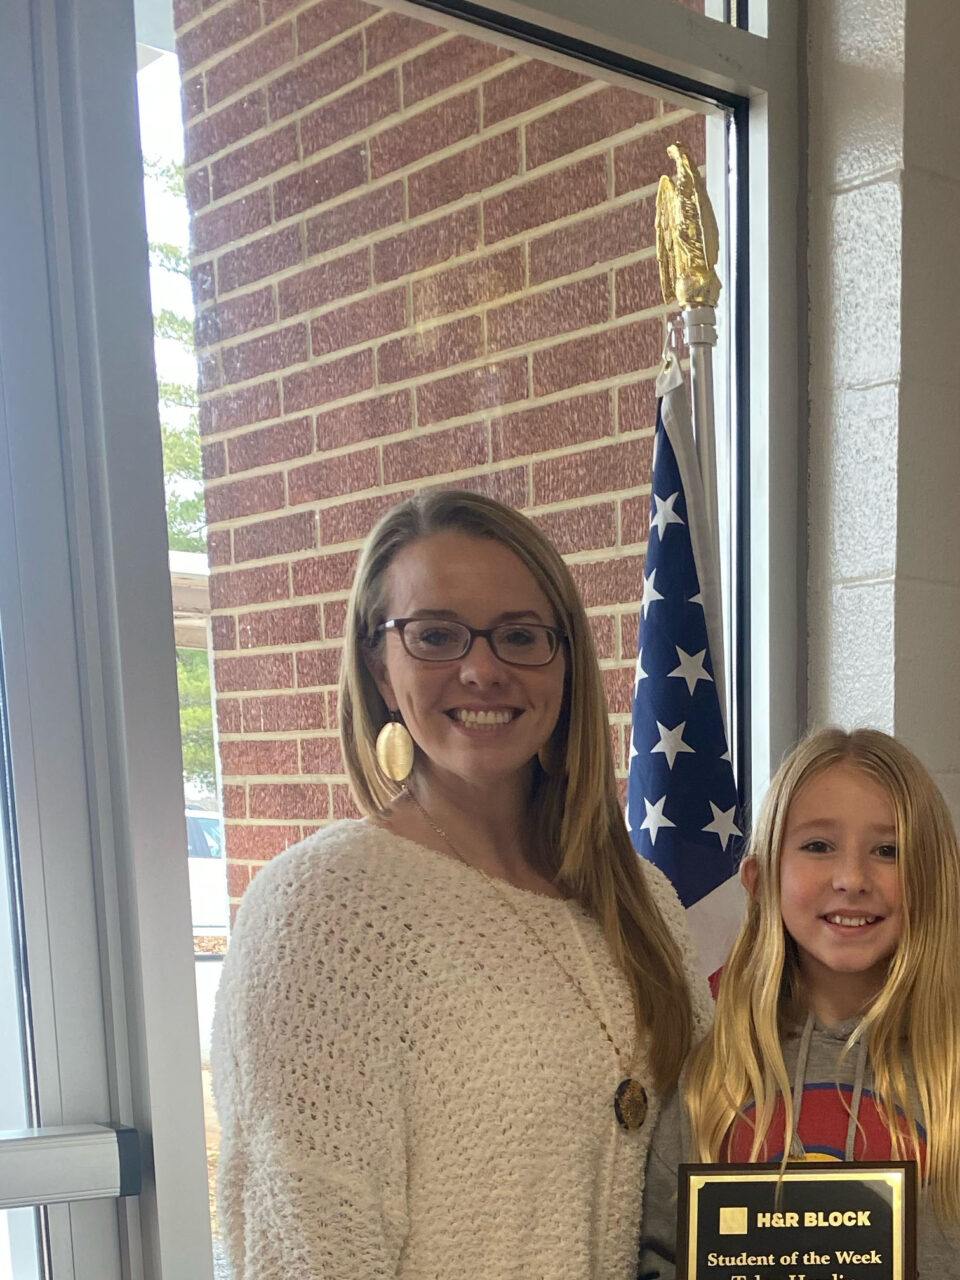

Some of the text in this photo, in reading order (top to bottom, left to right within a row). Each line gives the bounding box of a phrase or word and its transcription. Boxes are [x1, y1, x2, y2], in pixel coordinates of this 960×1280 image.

[757, 1211, 871, 1228] H&R BLOCK
[707, 1250, 882, 1267] Student of the Week
